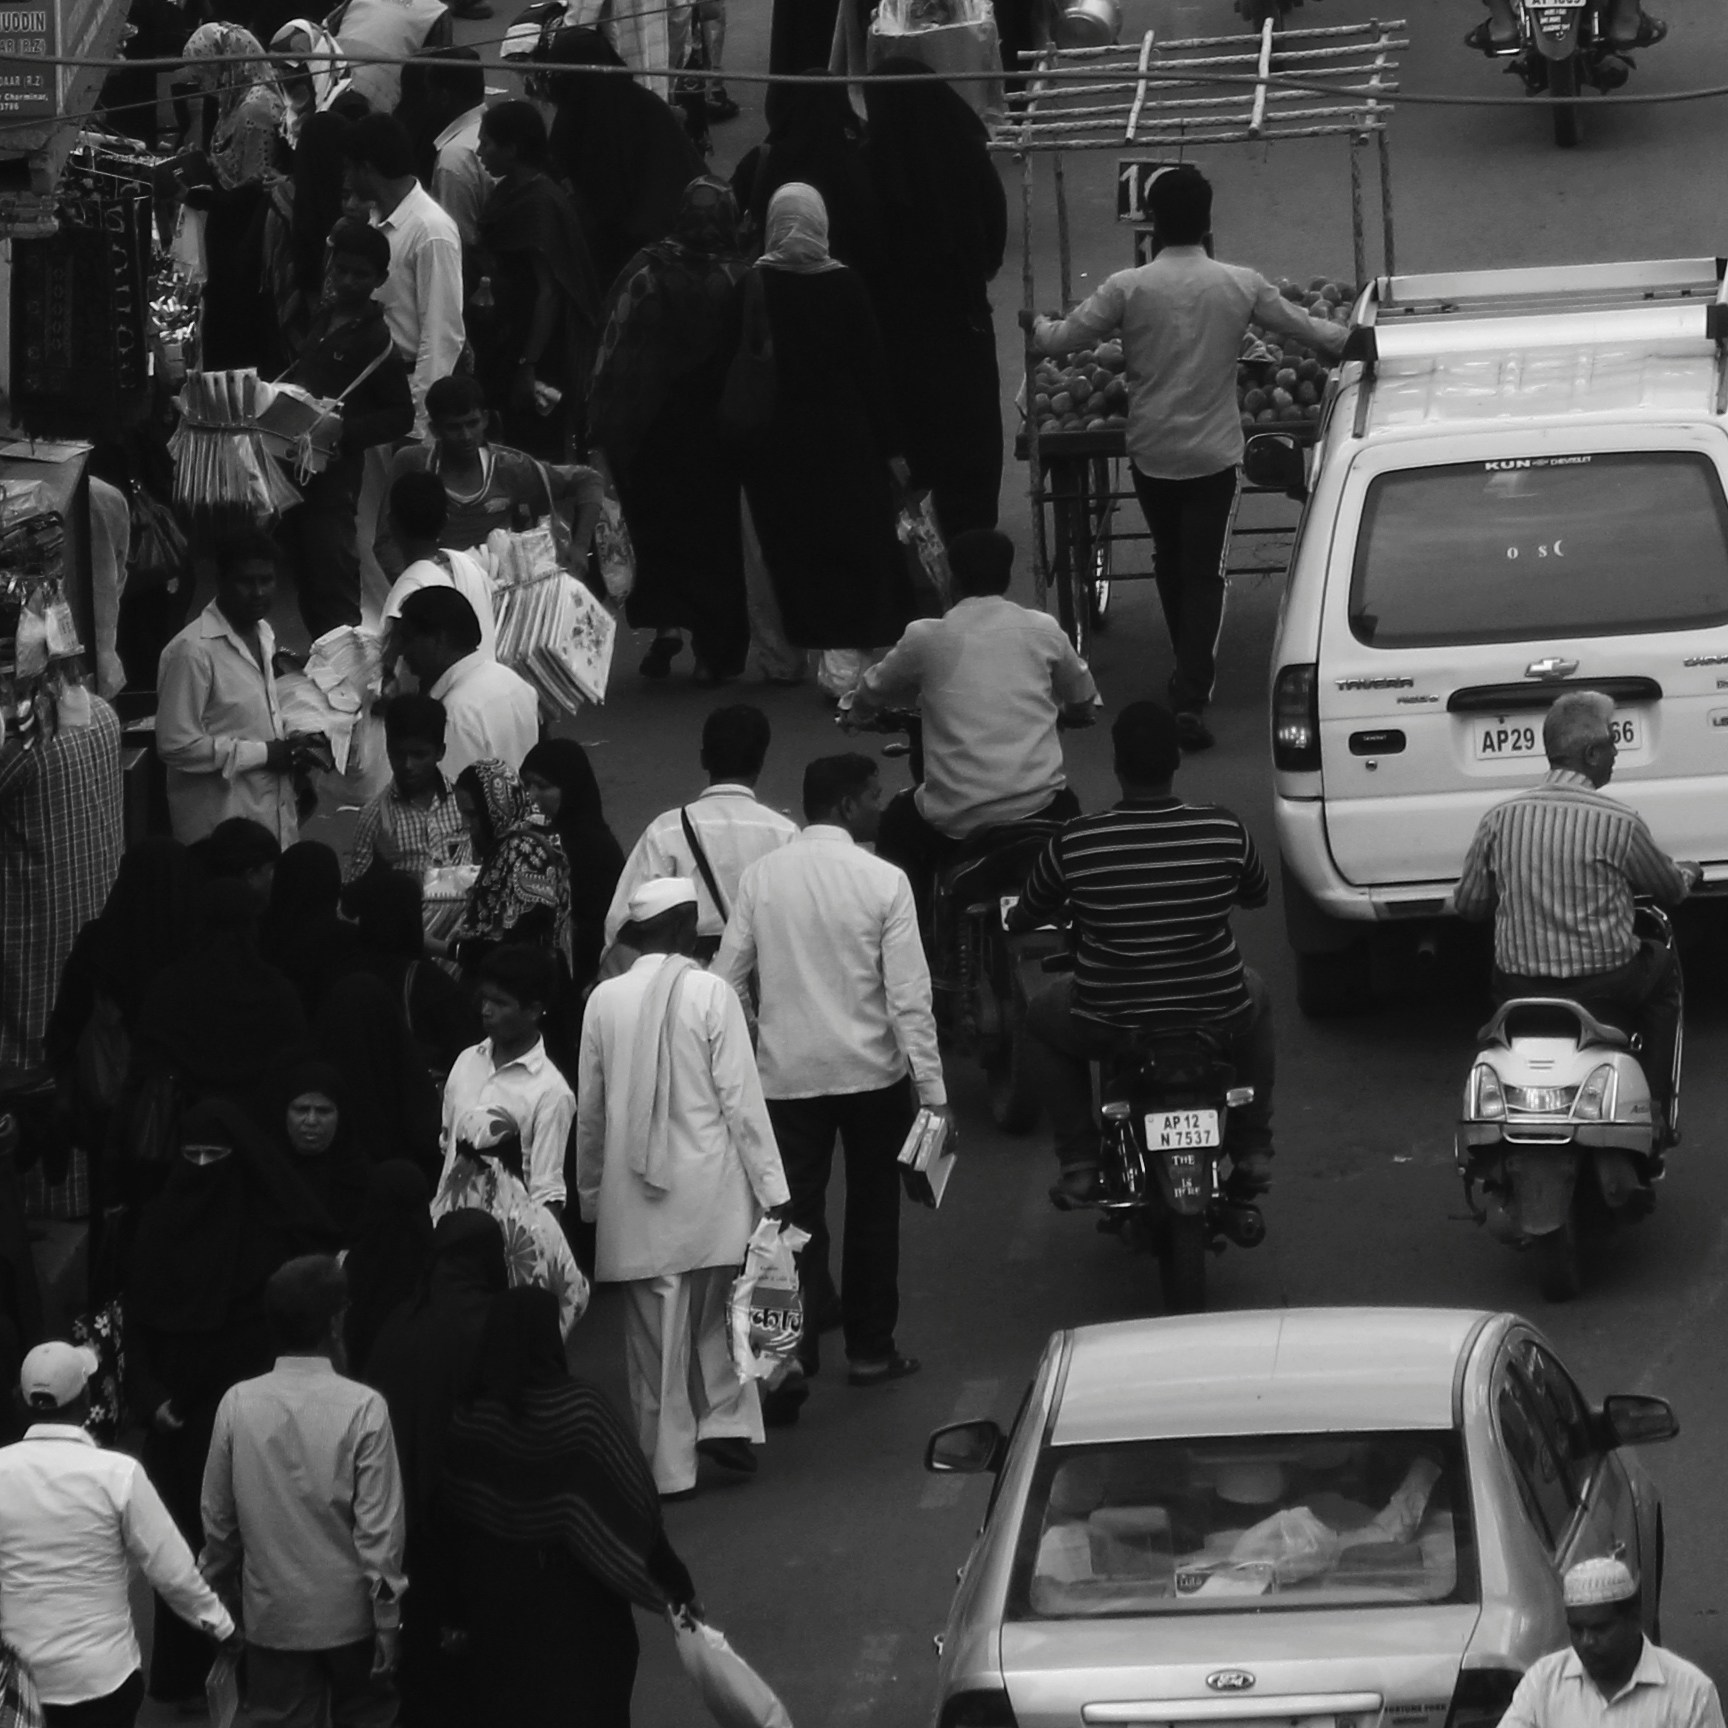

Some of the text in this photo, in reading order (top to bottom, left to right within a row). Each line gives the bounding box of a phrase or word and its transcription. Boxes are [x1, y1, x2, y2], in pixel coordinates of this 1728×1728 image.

[0, 11, 46, 33] UDDIN
[1484, 459, 1532, 471] KUN
[1335, 677, 1414, 692] TAVERA
[1482, 726, 1536, 753] AP29
[1164, 1113, 1200, 1131] AP 12
[1160, 1130, 1212, 1146] N 7537
